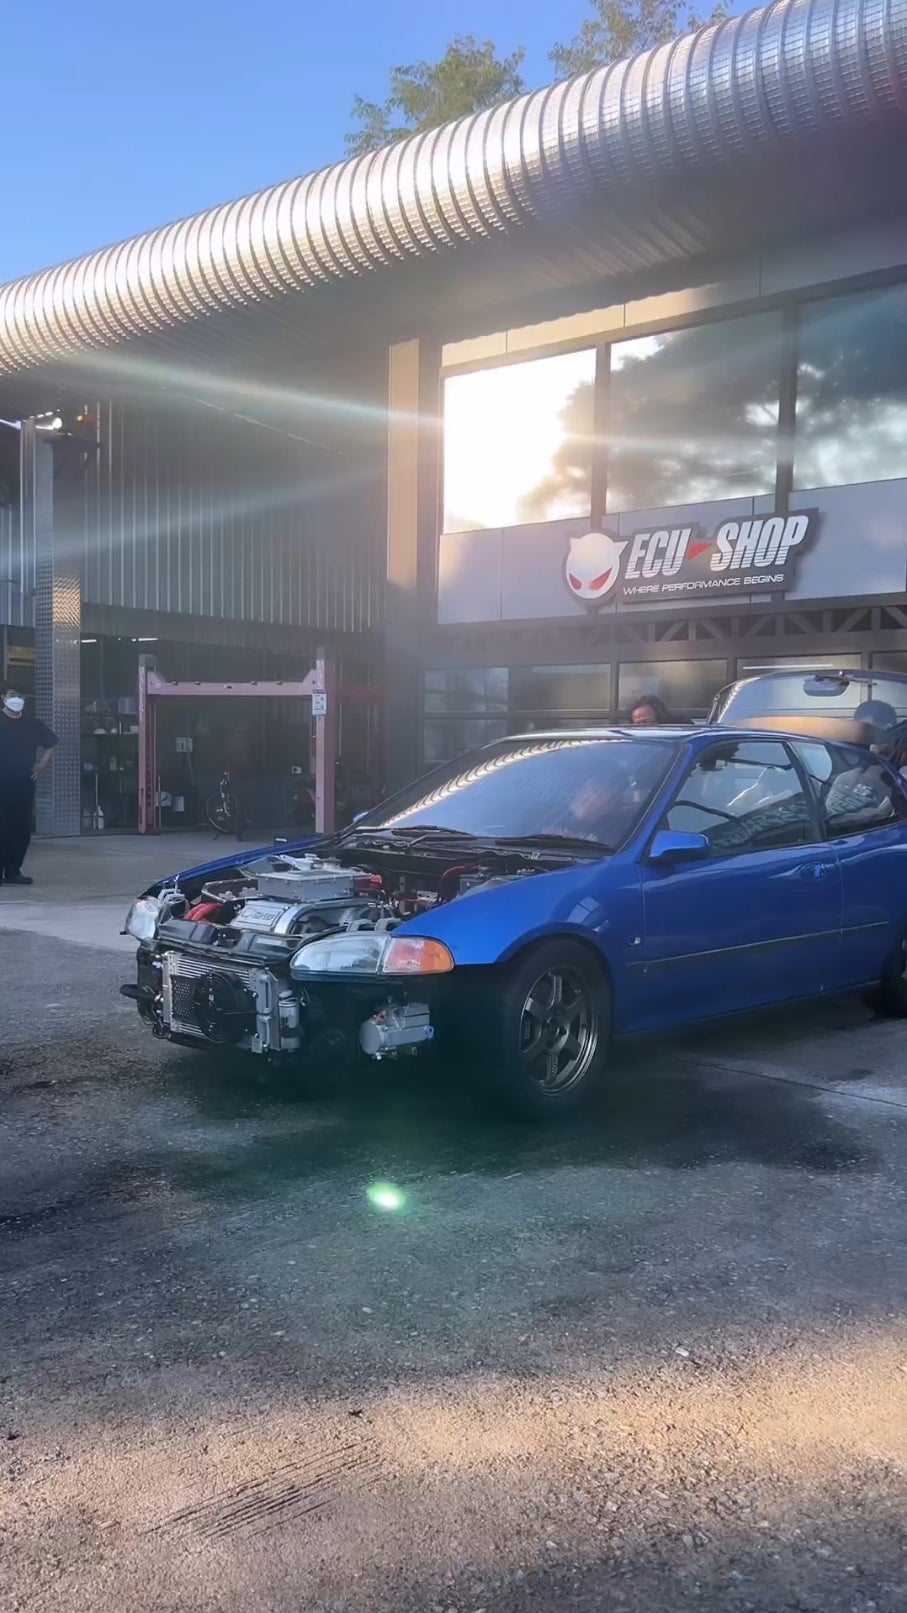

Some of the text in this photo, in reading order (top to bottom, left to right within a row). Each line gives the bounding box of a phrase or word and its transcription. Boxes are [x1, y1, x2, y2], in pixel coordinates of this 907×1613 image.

[624, 515, 809, 580] ECU SHOP
[623, 574, 784, 595] WHERE PERFORMANCE BEGINS
